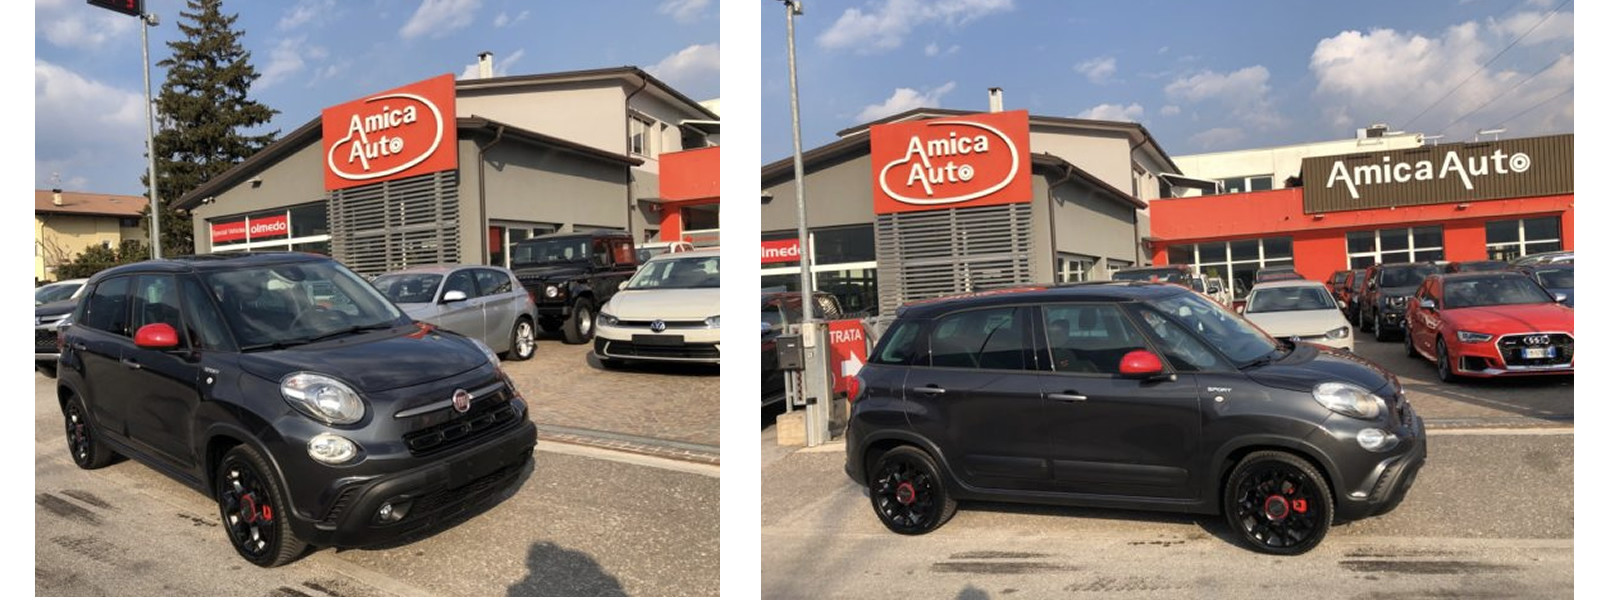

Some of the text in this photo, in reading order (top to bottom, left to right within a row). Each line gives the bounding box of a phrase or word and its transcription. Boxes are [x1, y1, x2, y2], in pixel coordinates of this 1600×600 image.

[349, 105, 417, 144] Amica
[348, 135, 404, 170] Auto
[905, 132, 989, 168] Amica
[906, 161, 974, 195] Auto
[1326, 149, 1531, 199] Amica Auto
[250, 221, 286, 234] olmedo
[829, 328, 862, 344] TRATA
